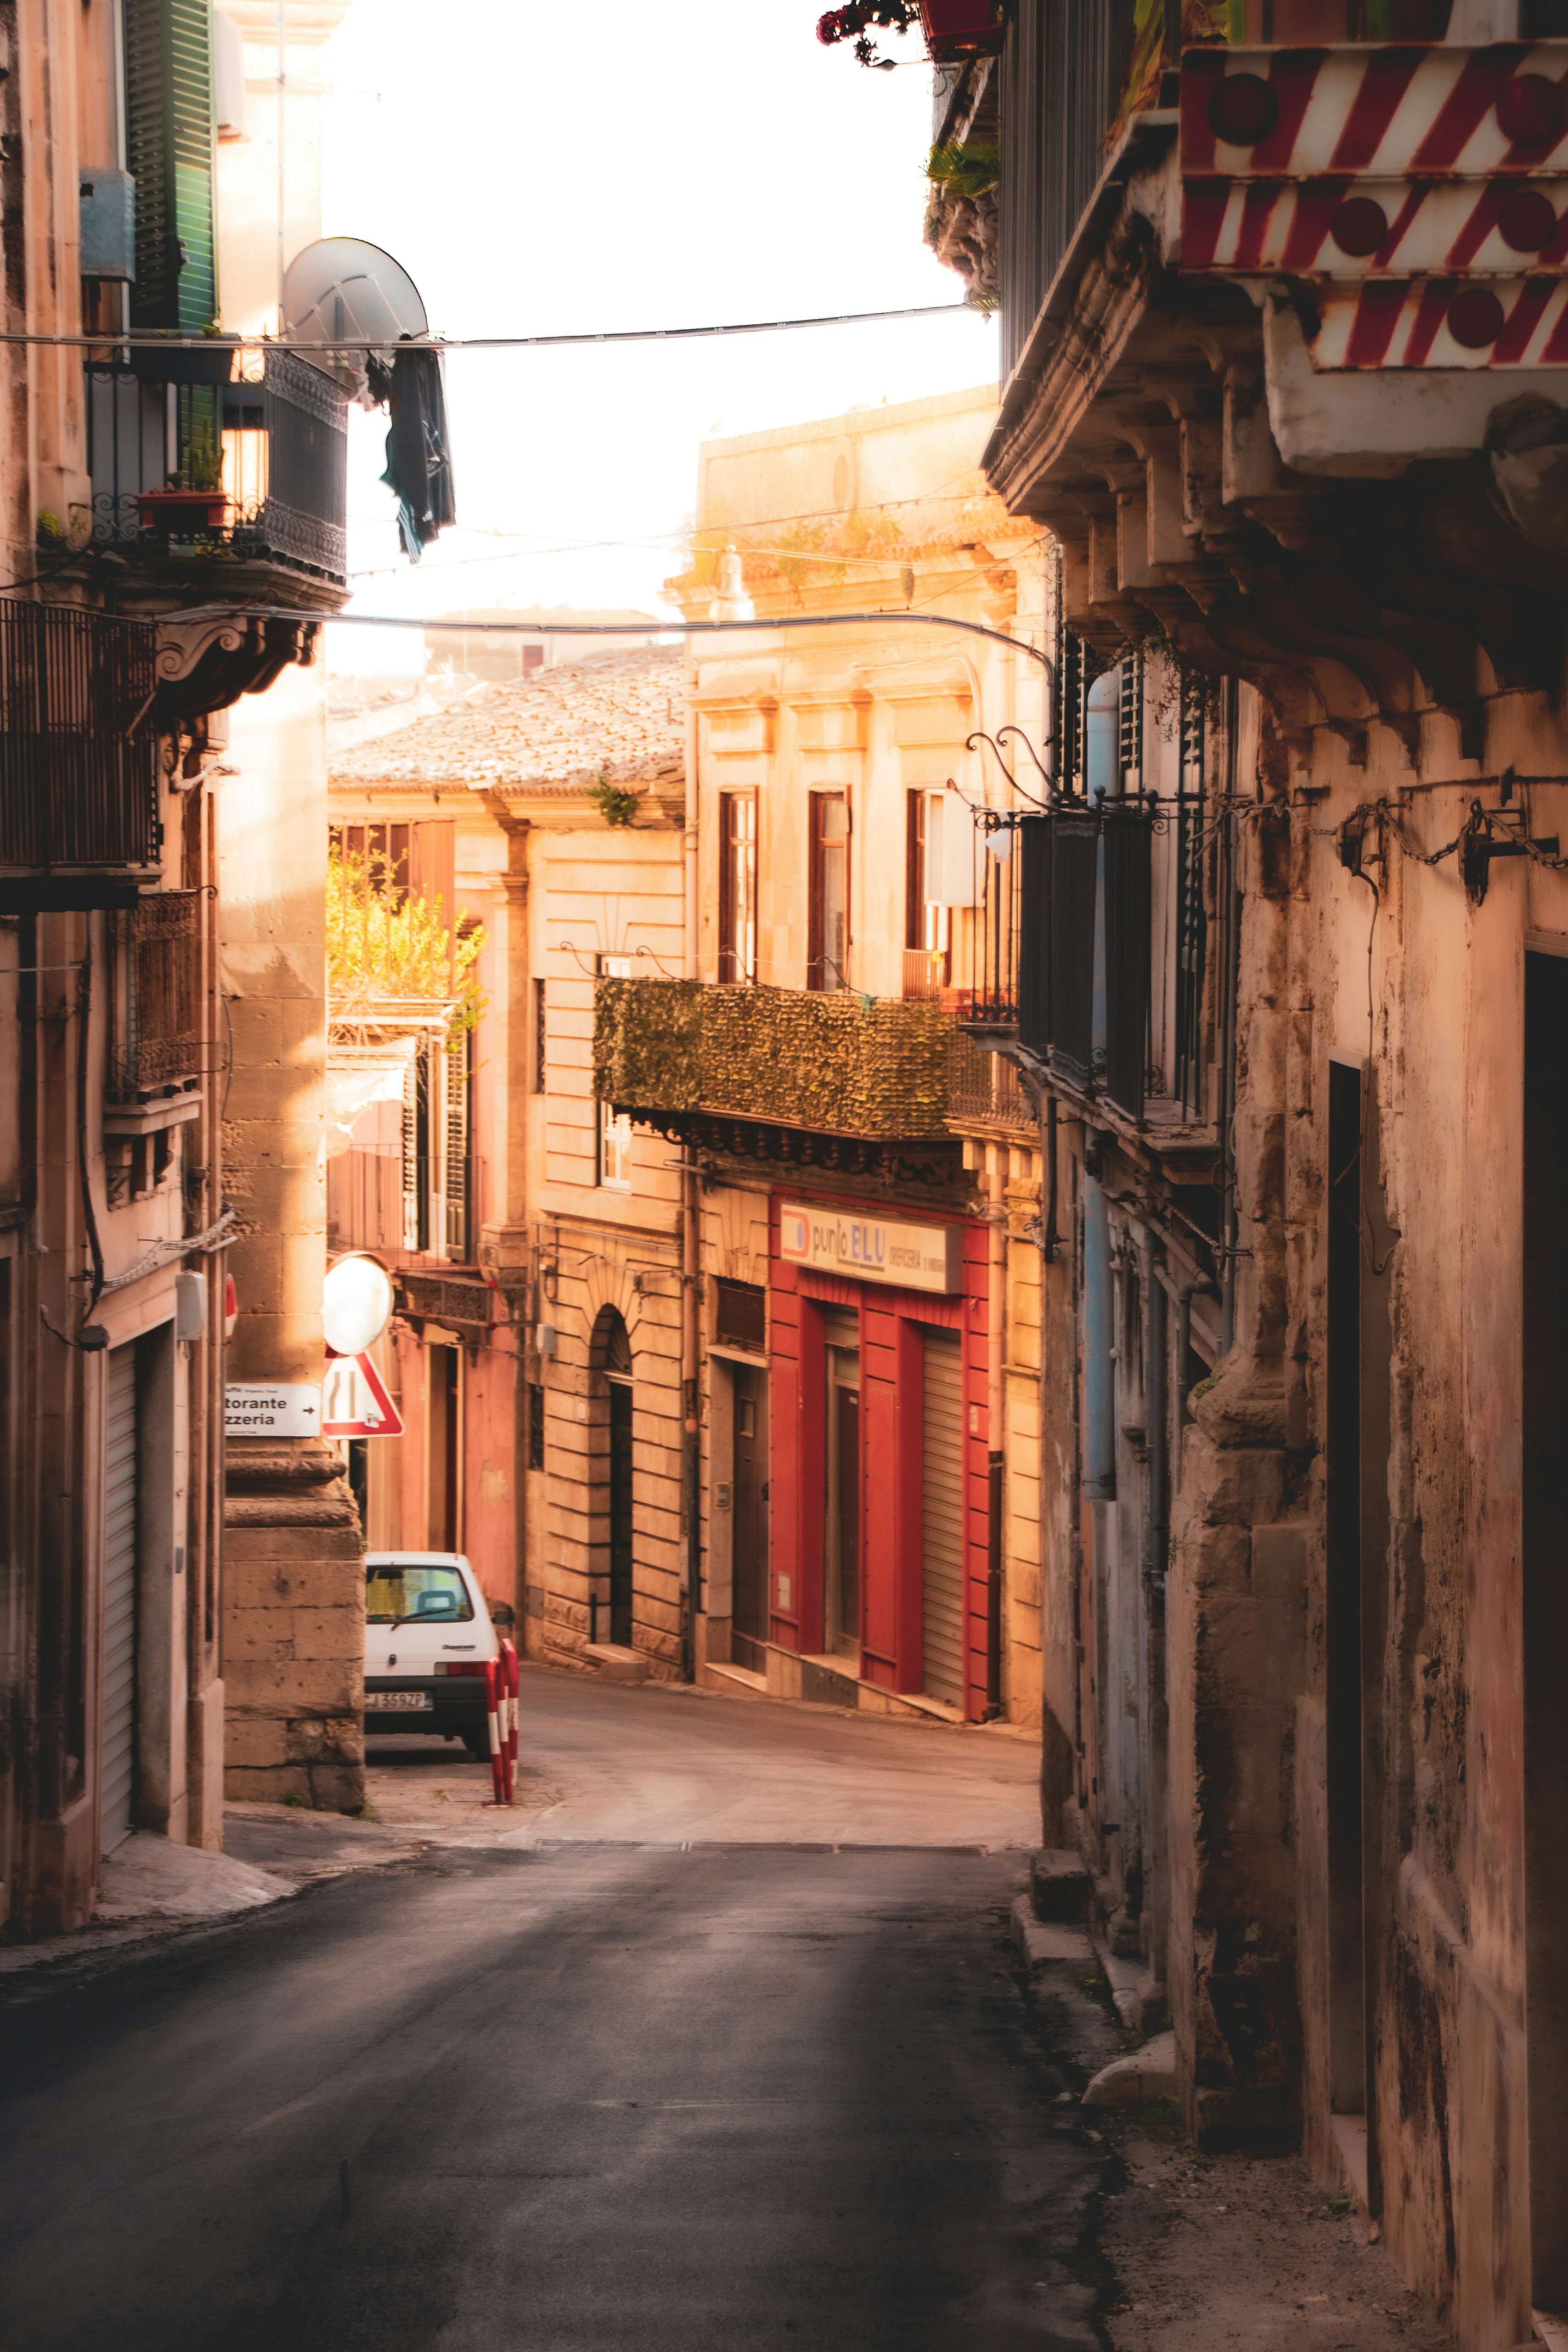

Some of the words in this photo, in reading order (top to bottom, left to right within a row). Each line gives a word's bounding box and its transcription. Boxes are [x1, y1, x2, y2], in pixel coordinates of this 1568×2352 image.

[813, 1219, 847, 1262] punto
[852, 1224, 886, 1263] ELU
[225, 1398, 287, 1409] torante
[225, 1413, 275, 1425] zzeria
